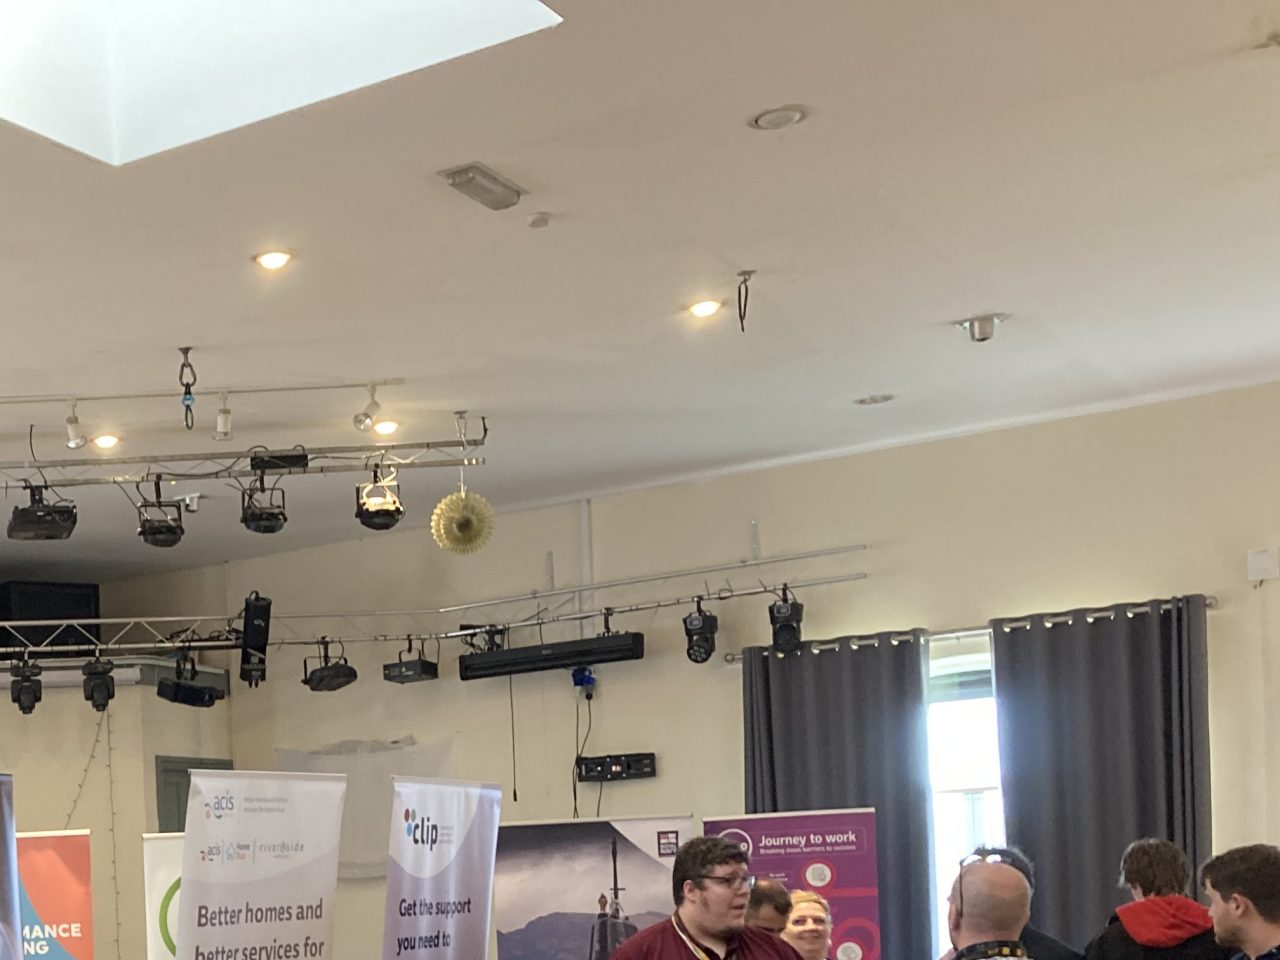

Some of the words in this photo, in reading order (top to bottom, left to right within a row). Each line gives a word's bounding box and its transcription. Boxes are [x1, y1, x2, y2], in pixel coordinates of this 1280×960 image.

[213, 790, 234, 811] acis
[412, 816, 439, 852] clip
[759, 834, 807, 848] Journey
[810, 833, 822, 844] to
[825, 830, 856, 843] work
[197, 904, 242, 928] Better
[245, 901, 293, 924] homes
[295, 897, 323, 921] and
[399, 898, 417, 917] Get
[419, 899, 434, 915] the
[435, 897, 471, 920] support
[303, 935, 325, 958] for
[396, 934, 416, 956] you
[418, 930, 440, 950] need
[442, 932, 451, 947] to
